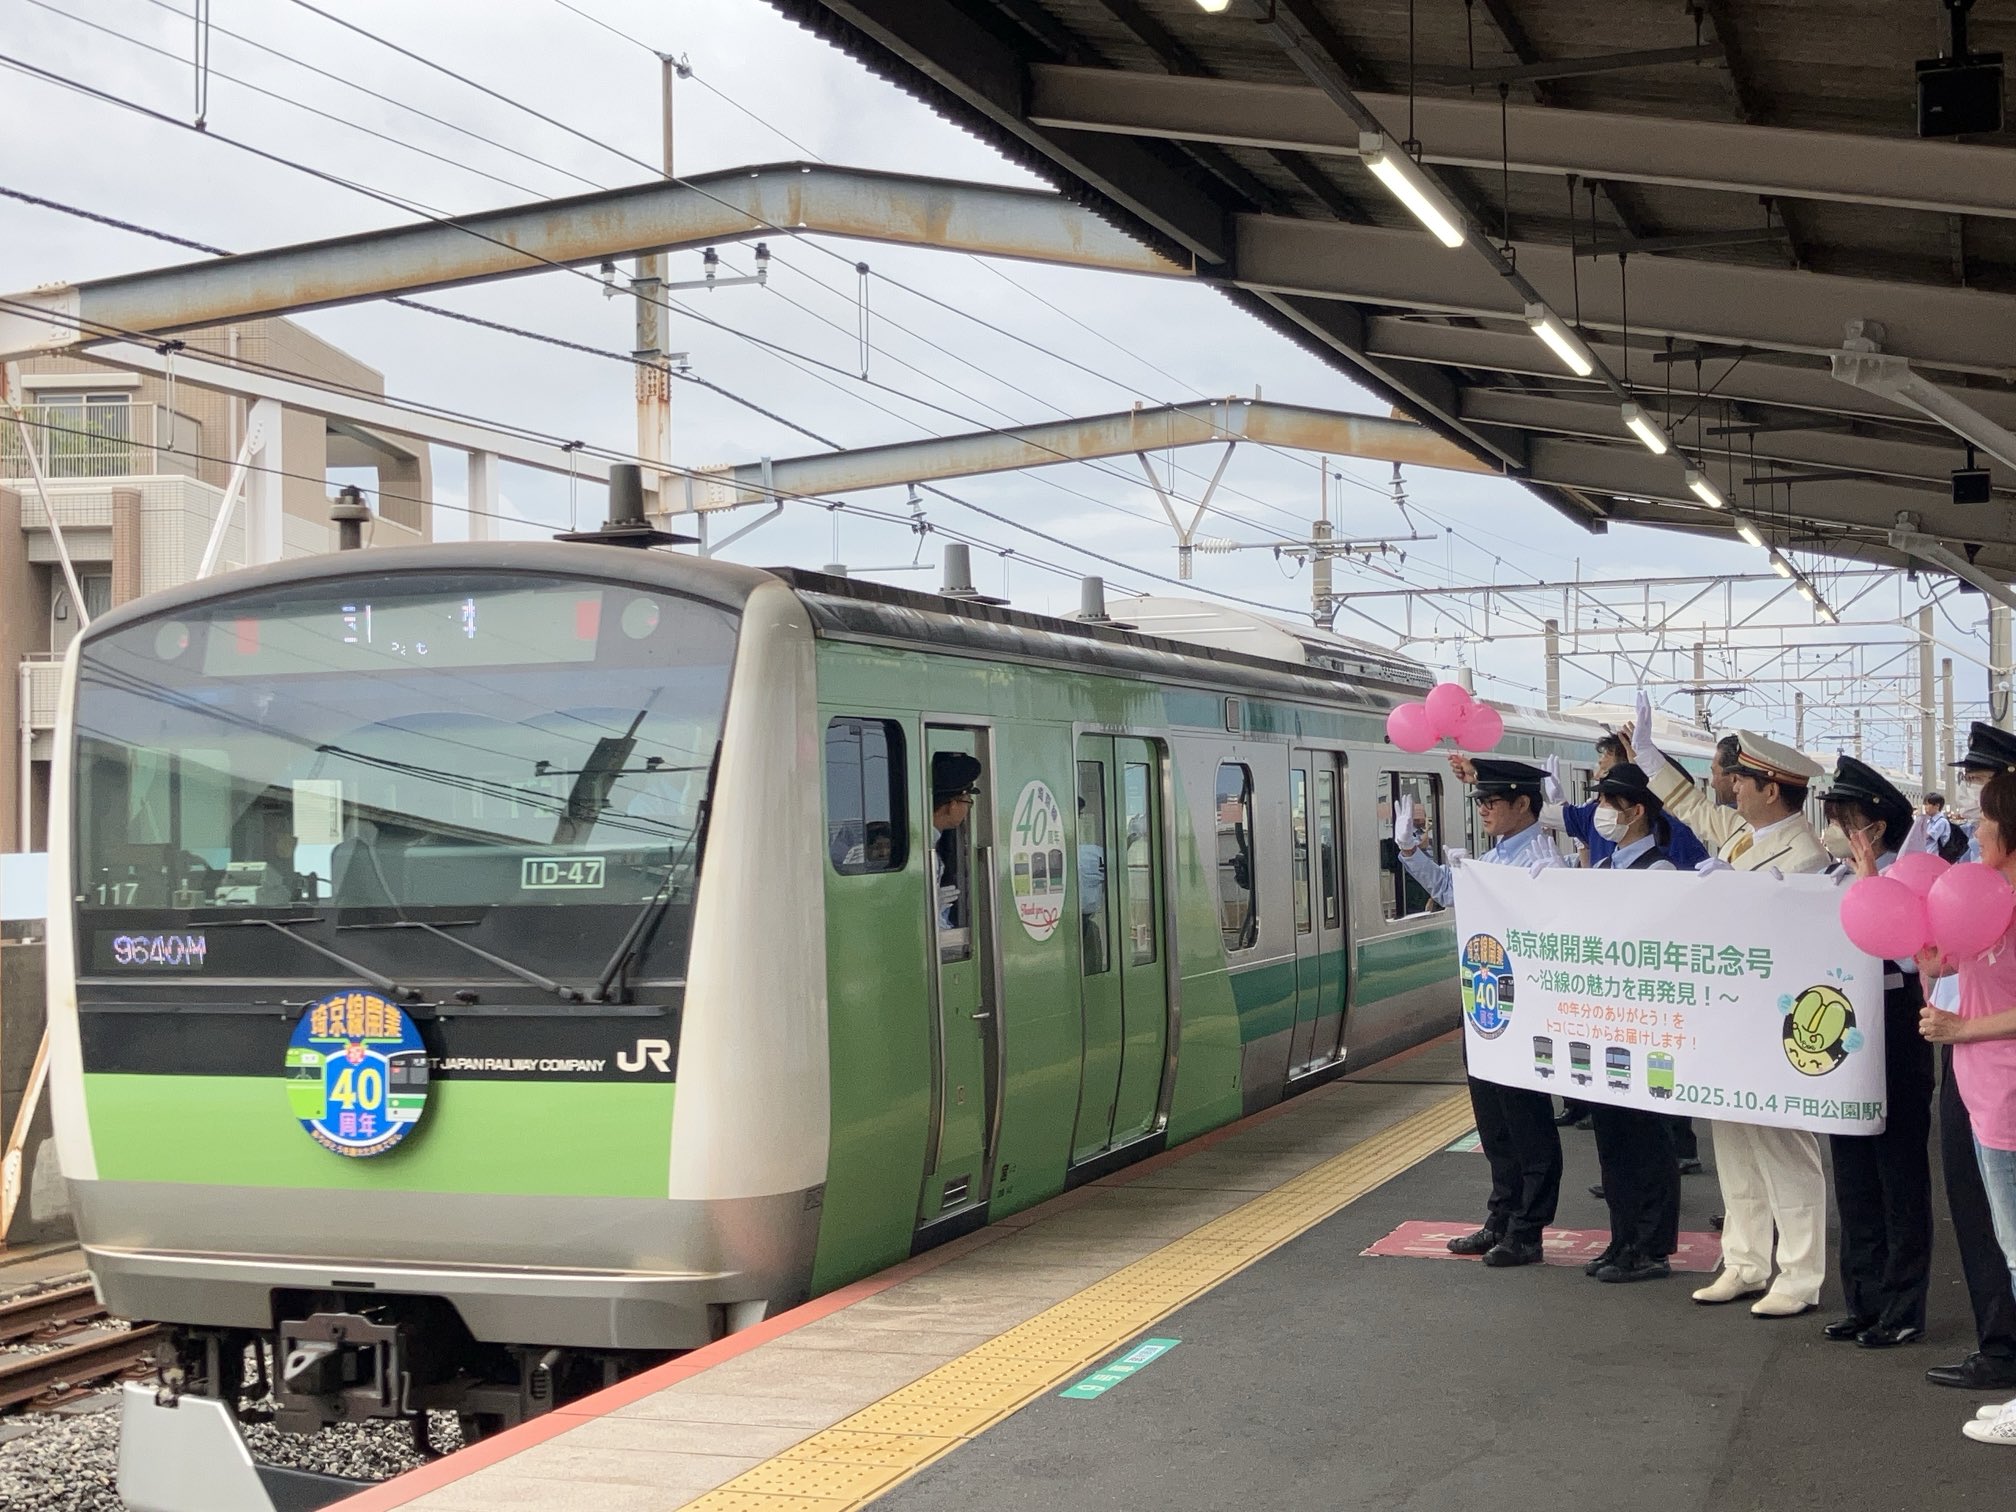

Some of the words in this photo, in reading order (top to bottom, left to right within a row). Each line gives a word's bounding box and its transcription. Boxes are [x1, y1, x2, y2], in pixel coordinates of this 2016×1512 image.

[1016, 788, 1048, 847] 40
[530, 862, 601, 884] ID-47
[97, 883, 139, 905] 117
[113, 935, 207, 965] 9640M
[1506, 928, 1774, 979] 埼京線開業40周年記念号
[1476, 982, 1496, 1010] 40
[440, 1057, 484, 1071] JAPAN
[486, 1058, 538, 1072] RAILWAY
[539, 1059, 606, 1072] COMPANY
[616, 1038, 672, 1072] JR
[329, 1068, 383, 1110] 40
[1675, 1083, 1778, 1112] 2025.10.4
[1784, 1095, 1883, 1120] 戸田公園駅
[339, 1112, 378, 1137] 周年
